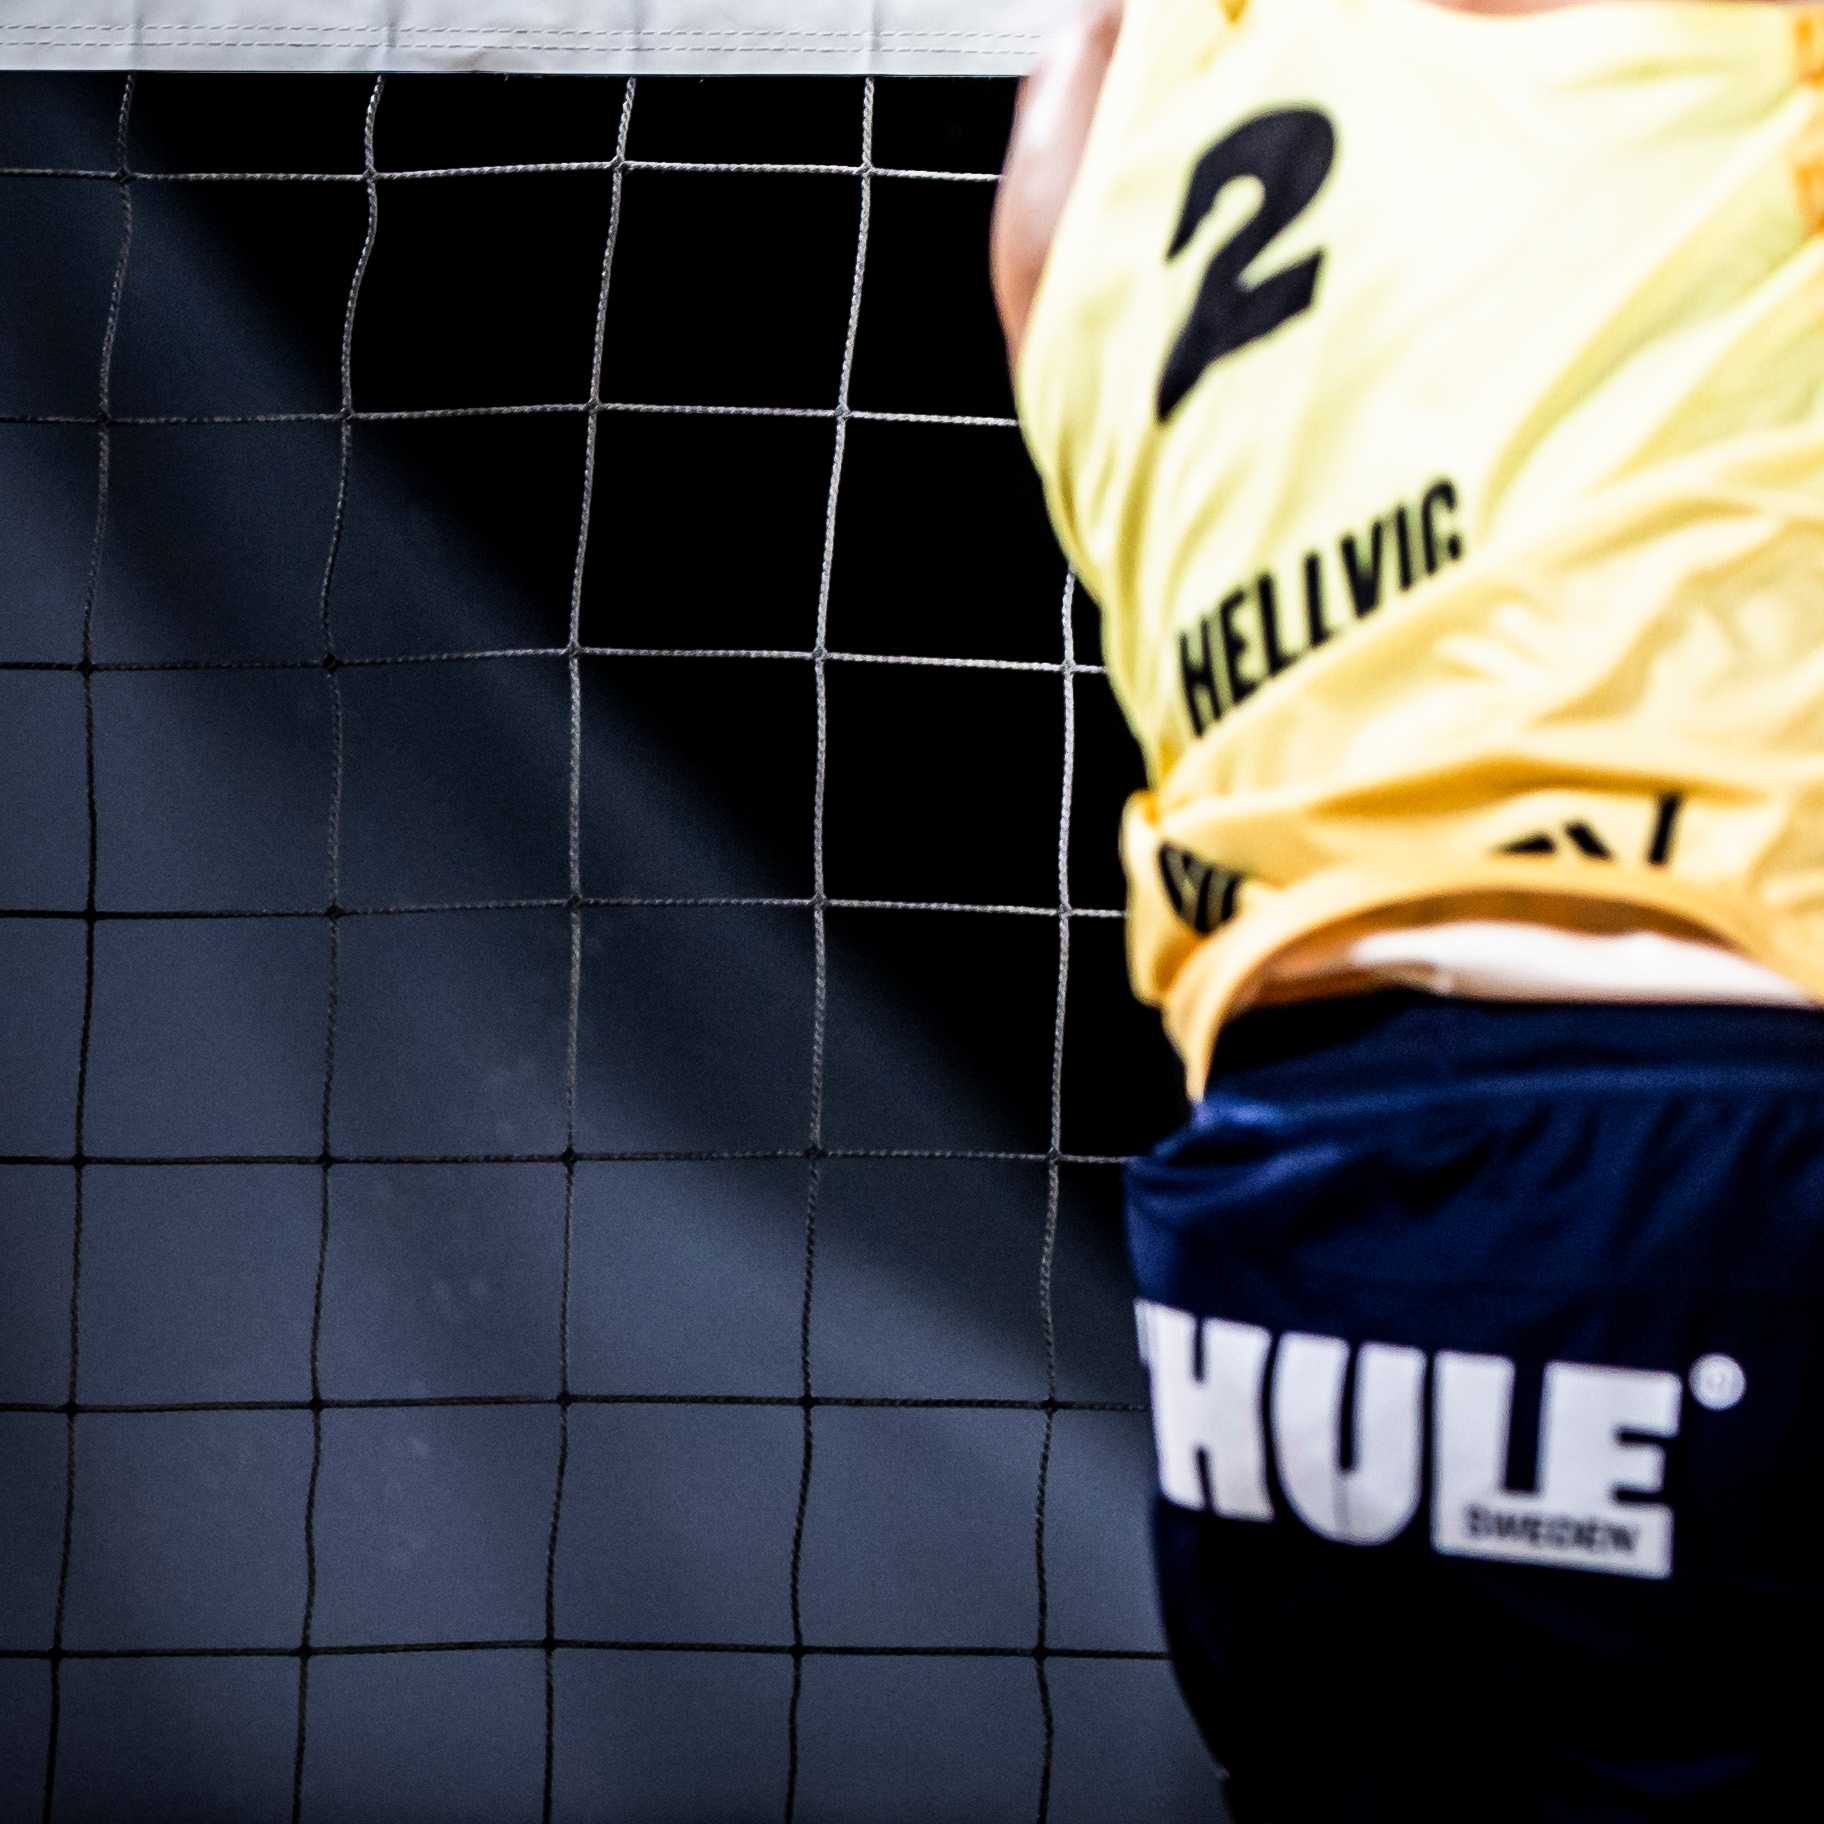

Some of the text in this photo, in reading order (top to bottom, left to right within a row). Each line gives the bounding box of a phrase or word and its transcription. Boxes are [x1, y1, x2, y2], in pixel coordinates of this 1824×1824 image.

[1155, 106, 1336, 426] 2
[1177, 477, 1465, 738] HELLVIG
[1134, 1297, 1683, 1581] HULE
